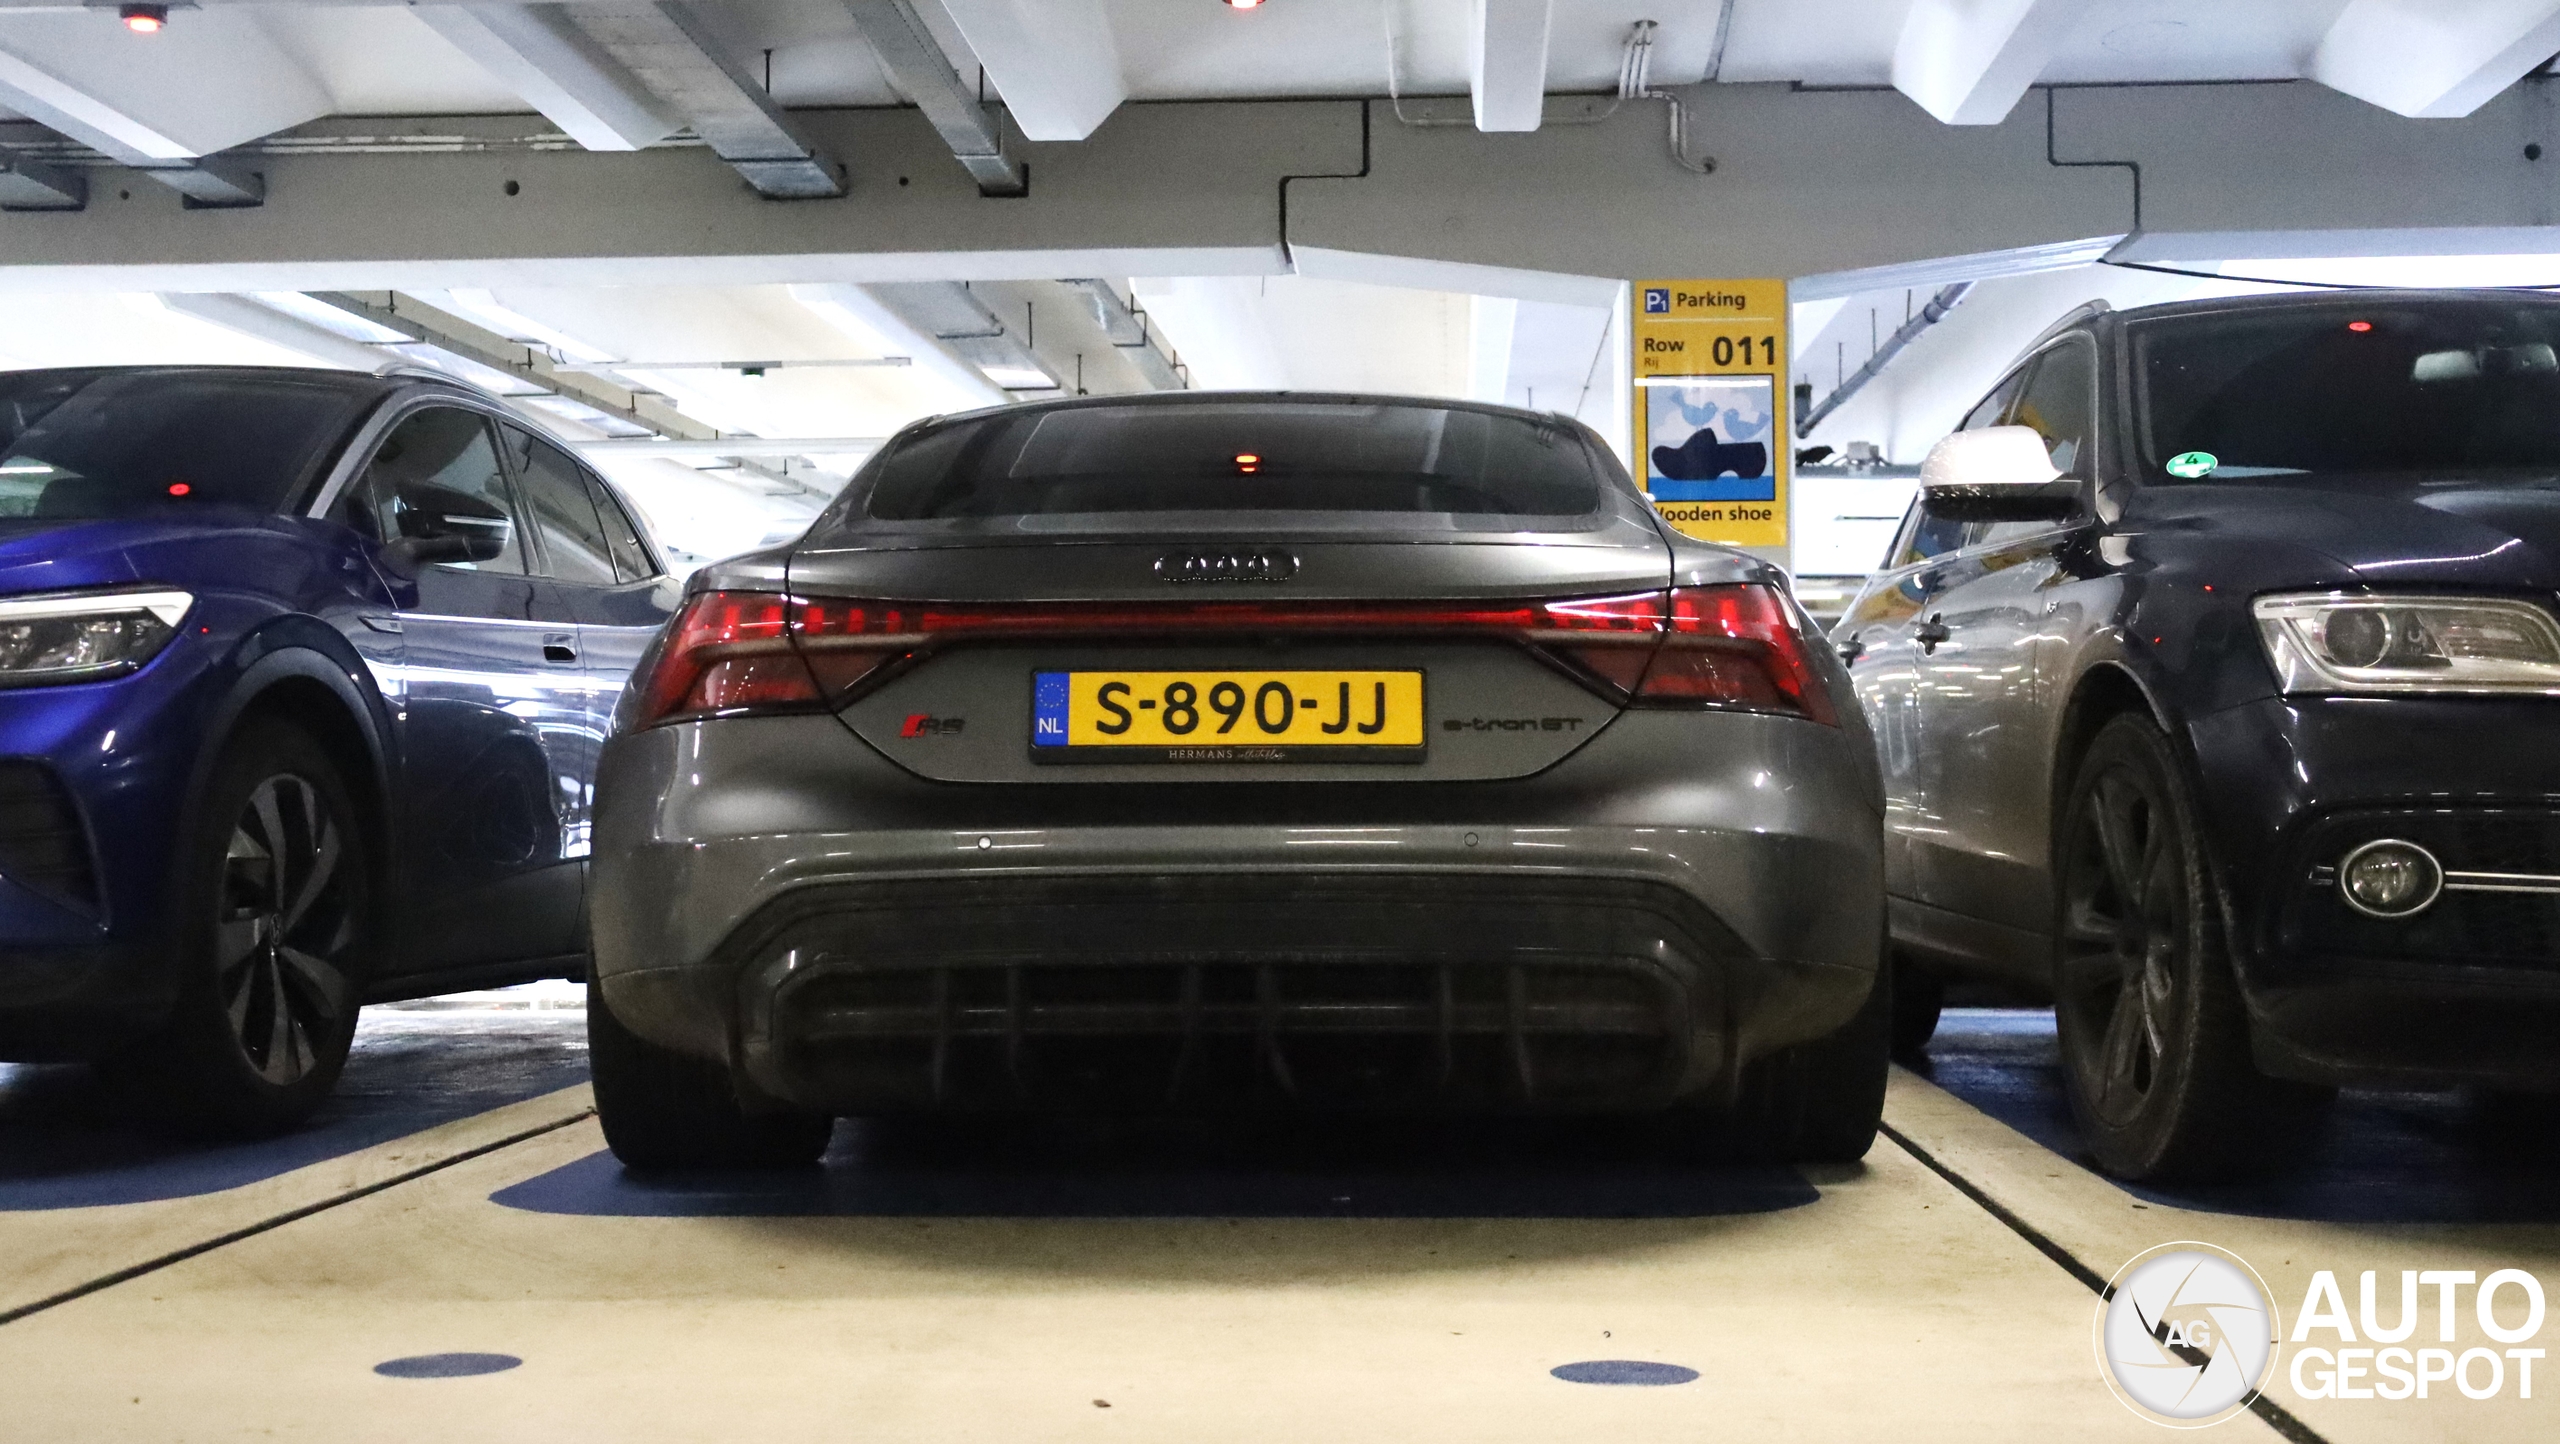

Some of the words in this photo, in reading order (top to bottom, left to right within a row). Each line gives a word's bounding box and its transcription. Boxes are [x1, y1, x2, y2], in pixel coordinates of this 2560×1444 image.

[1677, 291, 1746, 311] Parking
[1644, 338, 1685, 352] Row
[1712, 336, 1775, 366] 011
[1644, 357, 1659, 369] Rij
[2185, 453, 2199, 465] 4
[1729, 505, 1772, 521] shoe
[1038, 717, 1064, 734] NL
[1095, 681, 1386, 735] S-890-JJ
[1168, 749, 1234, 759] HERMANS
